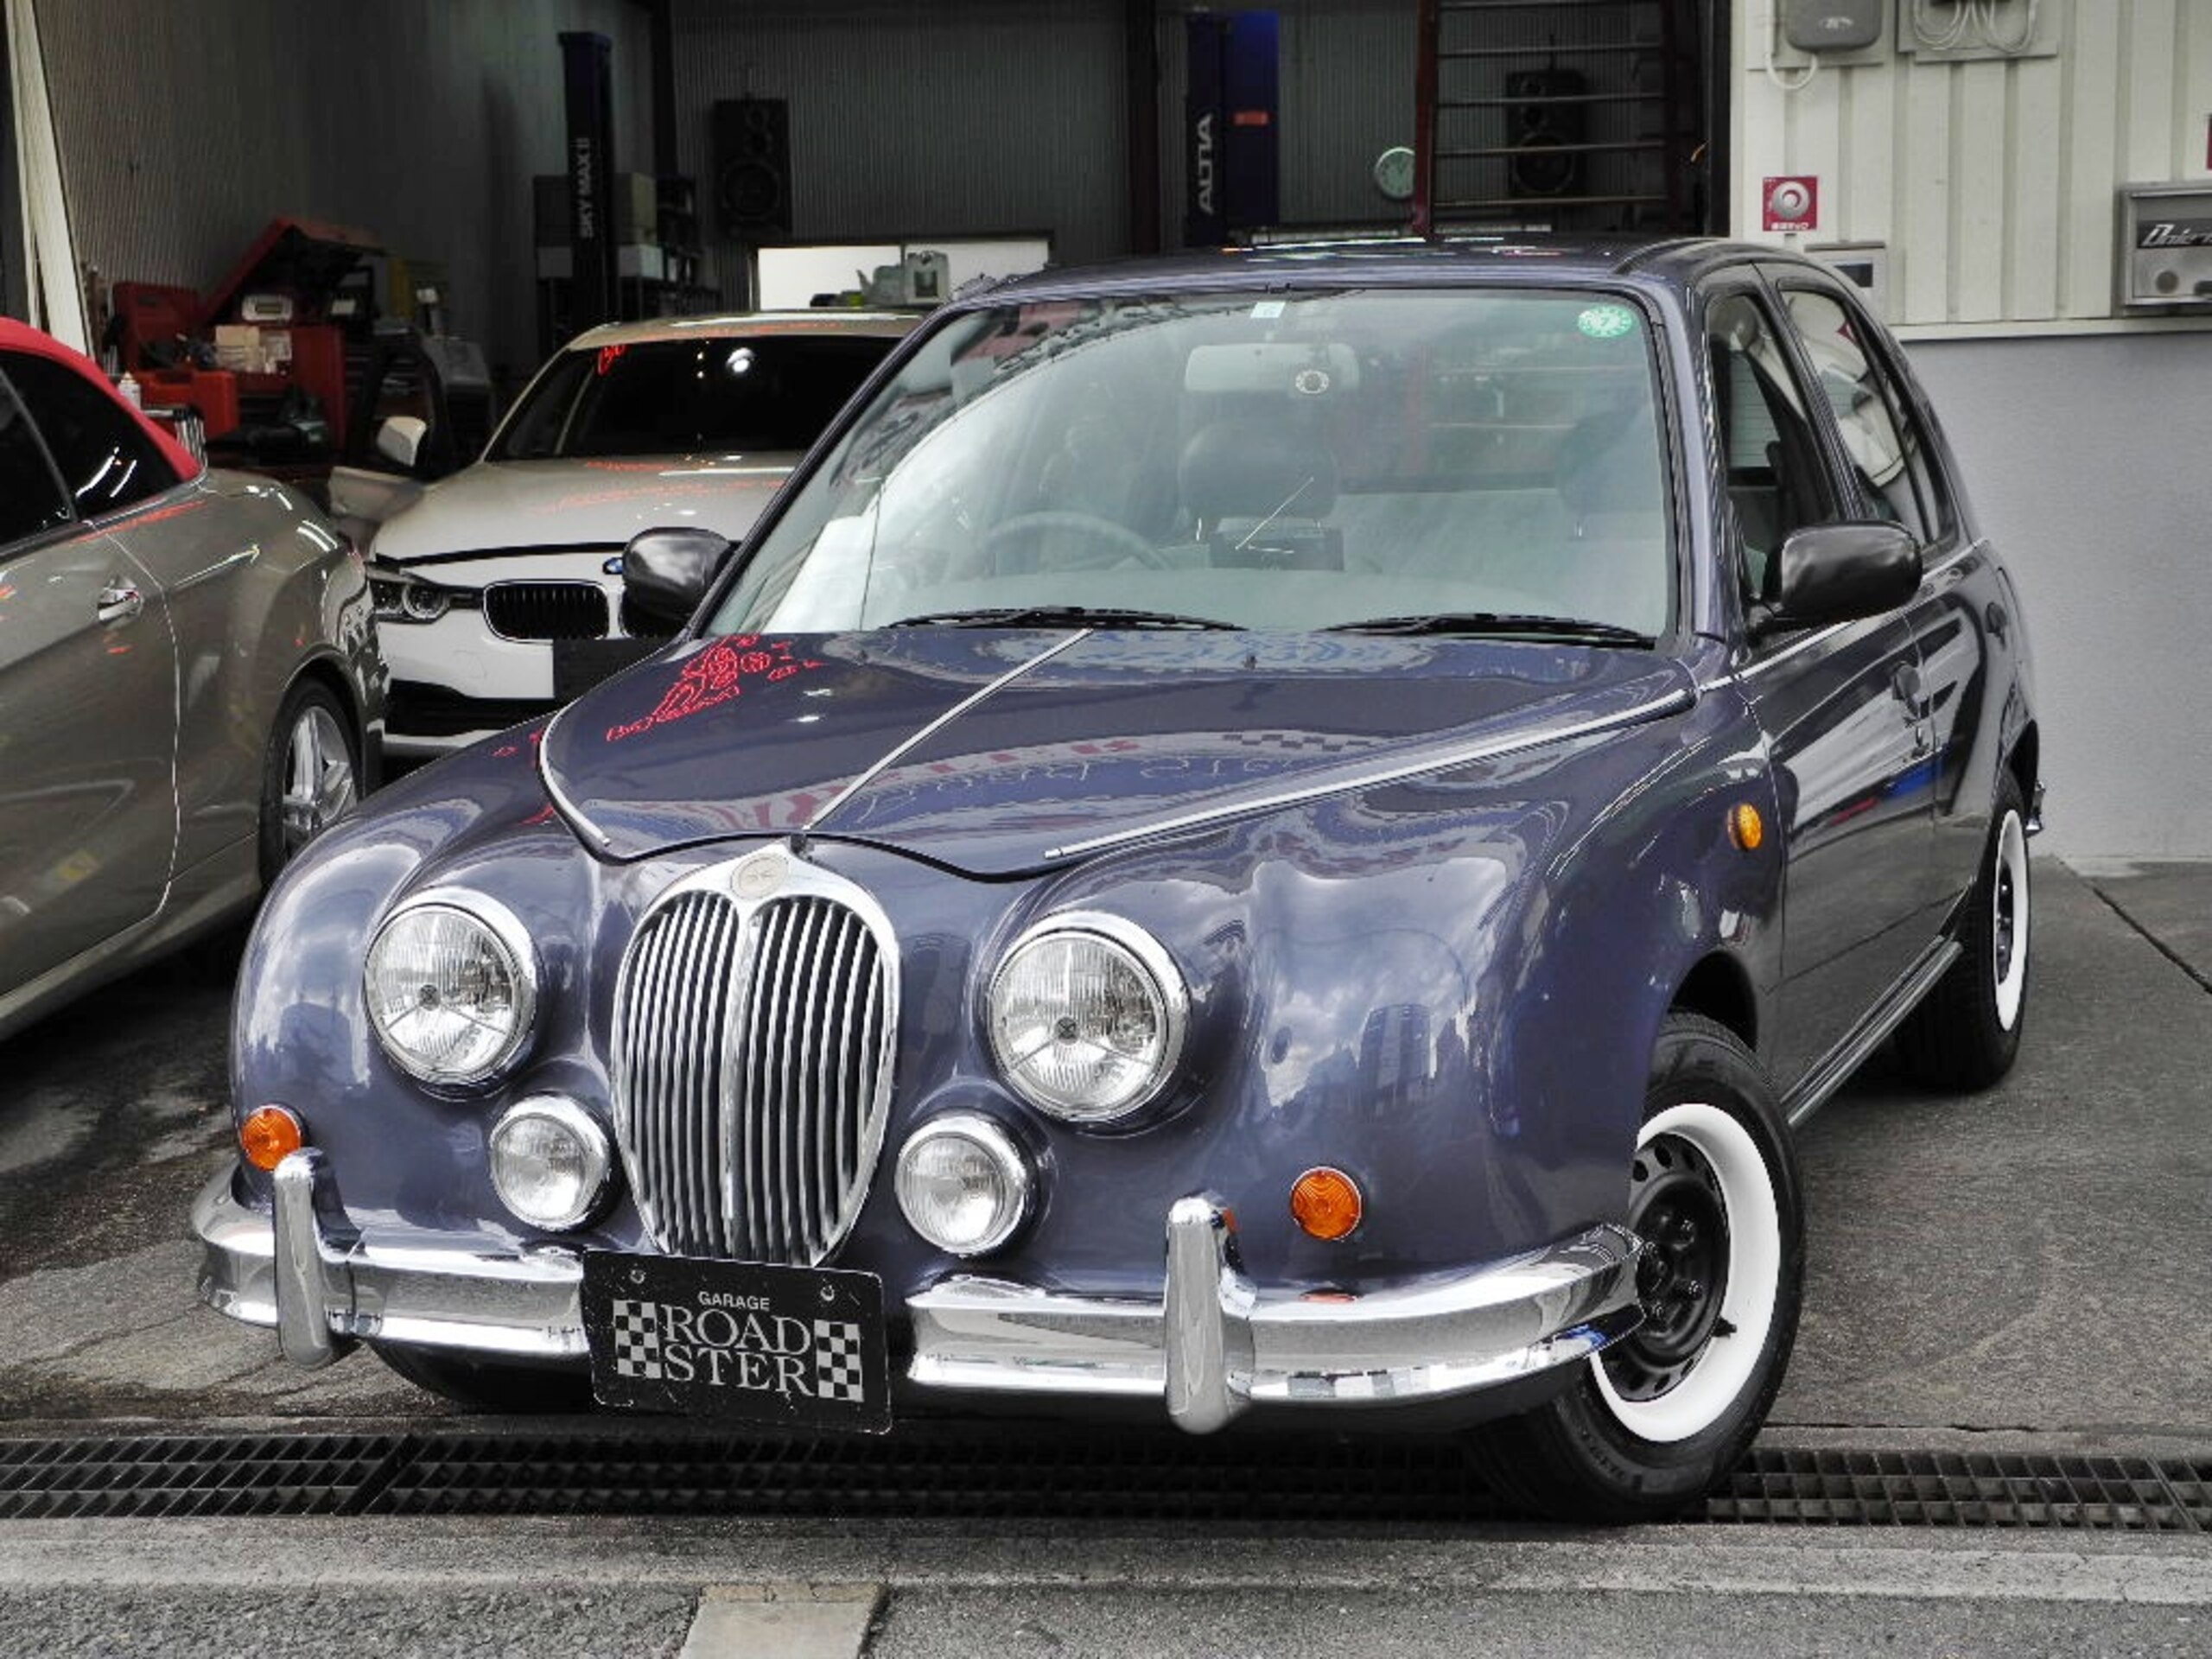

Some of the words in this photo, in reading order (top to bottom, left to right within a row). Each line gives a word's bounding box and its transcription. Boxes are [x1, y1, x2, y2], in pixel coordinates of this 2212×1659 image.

[577, 154, 592, 195] MAX
[578, 199, 594, 238] SKY
[697, 1291, 770, 1313] GARAGE
[660, 1304, 810, 1355] ROAD
[664, 1344, 815, 1396] STER
